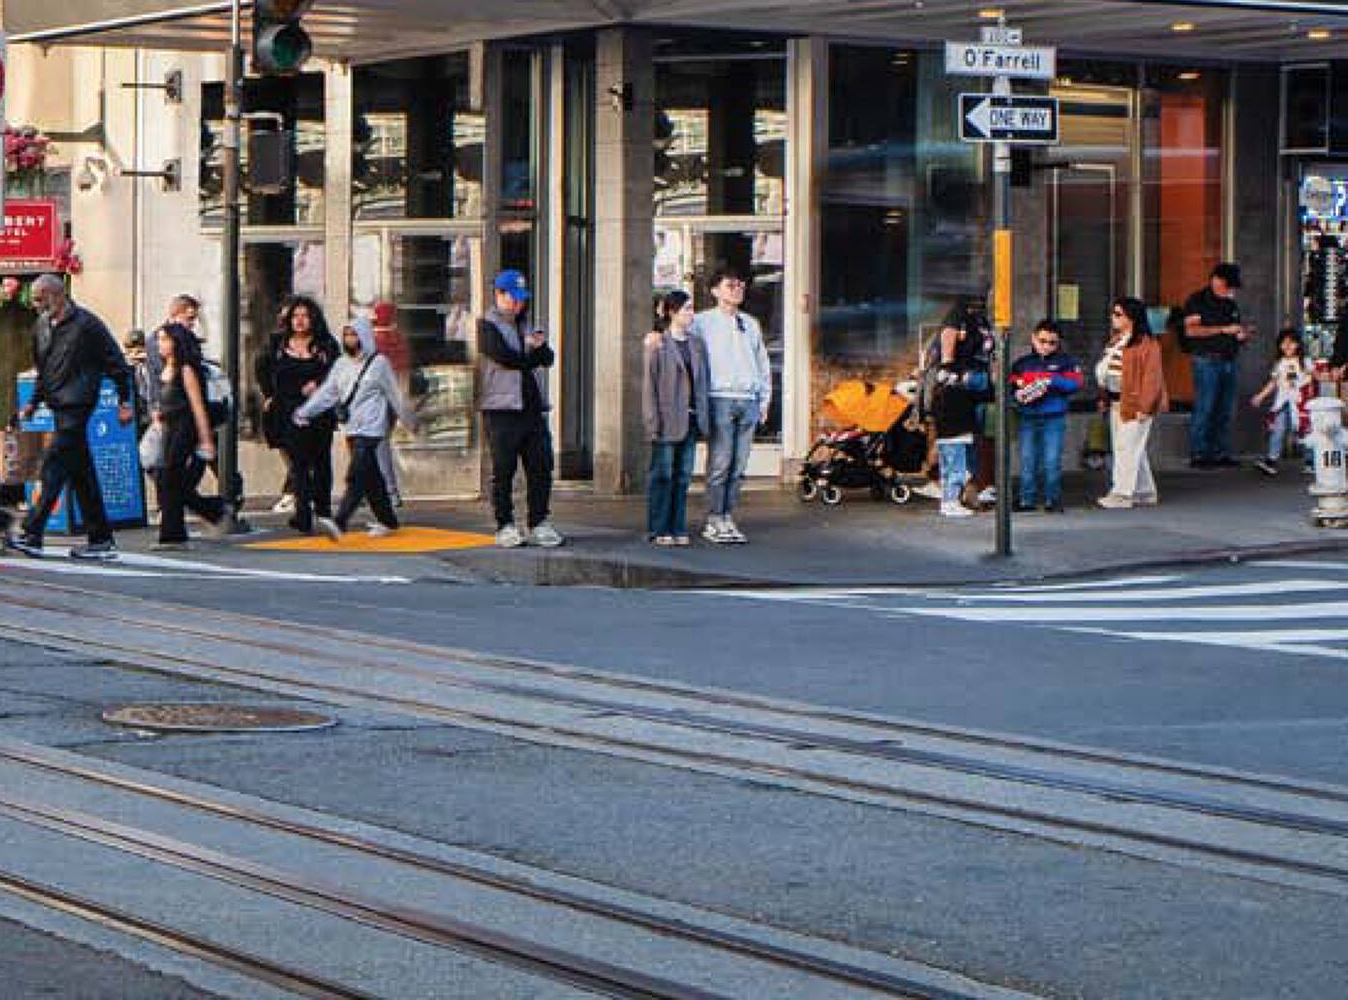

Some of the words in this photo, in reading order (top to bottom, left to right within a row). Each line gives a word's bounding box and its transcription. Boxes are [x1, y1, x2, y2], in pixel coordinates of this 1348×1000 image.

[964, 48, 1041, 71] O'Farrell
[990, 109, 1016, 126] ONE
[1020, 111, 1047, 127] WAY
